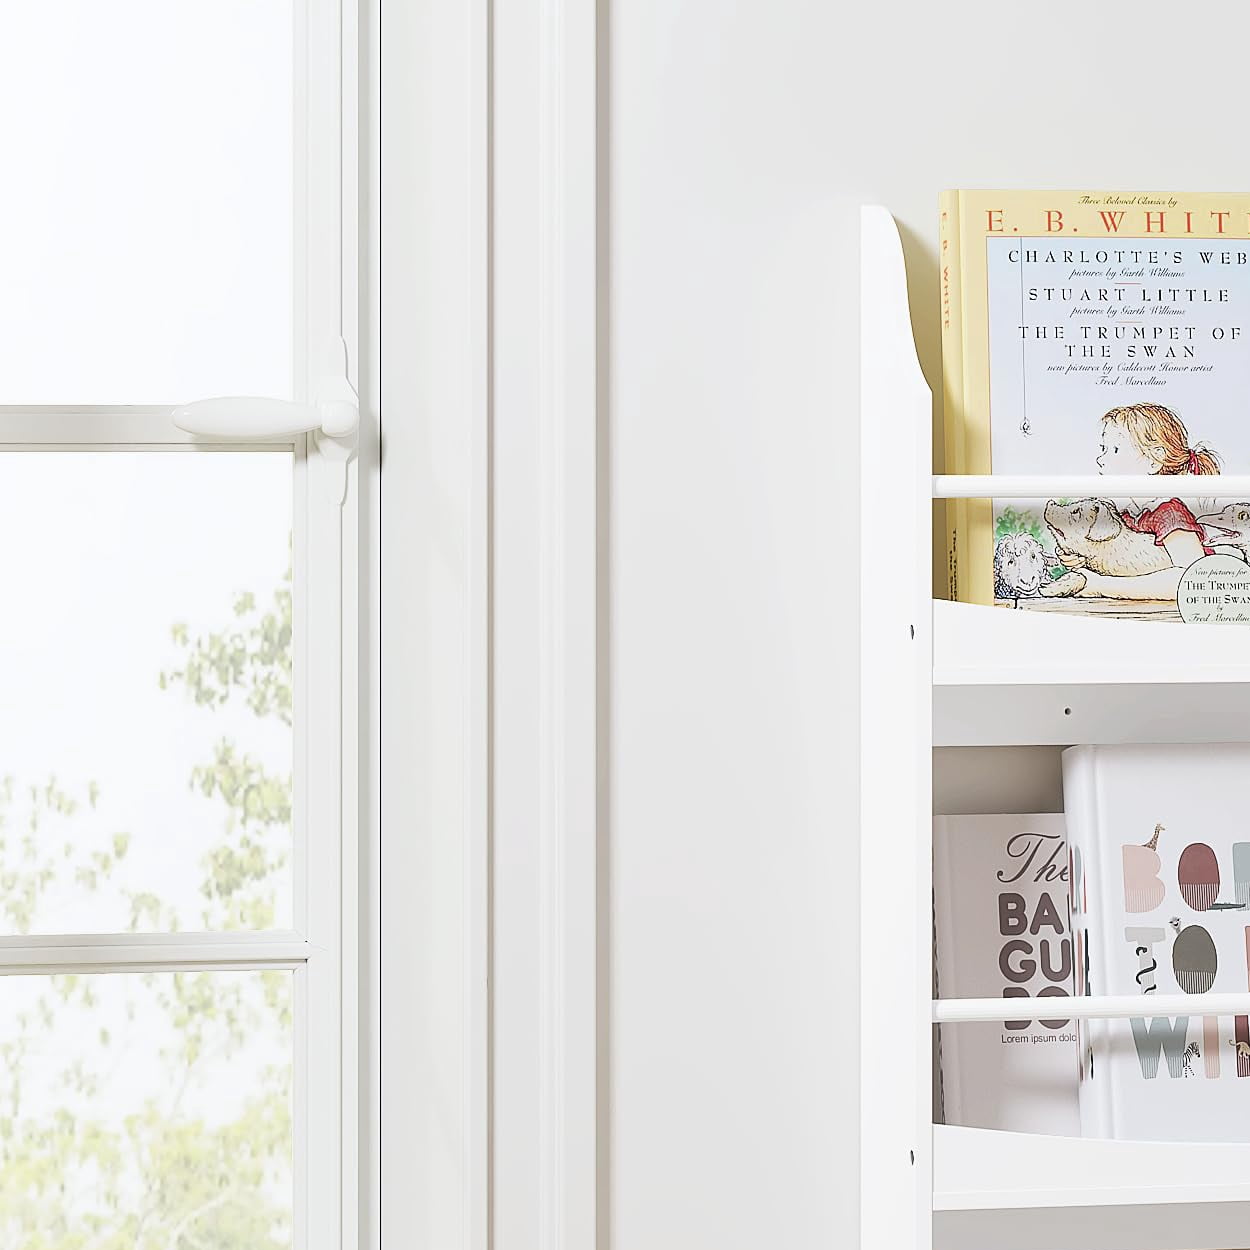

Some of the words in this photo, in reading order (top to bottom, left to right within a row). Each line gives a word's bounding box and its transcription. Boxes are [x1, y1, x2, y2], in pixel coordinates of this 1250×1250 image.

[1078, 195, 1100, 205] Three
[1103, 196, 1136, 205] Beloved
[1138, 196, 1166, 205] Classics
[1168, 197, 1178, 208] by
[1008, 250, 1183, 264] CHARLOTTE'S
[1199, 252, 1248, 265] WEB
[1069, 268, 1102, 280] pictures
[1105, 268, 1117, 280] by
[1119, 267, 1144, 277] Garth
[1149, 267, 1186, 278] Williams
[1028, 288, 1126, 301] STUART
[1141, 289, 1229, 302] LITTLE
[1070, 306, 1104, 318] pictures
[1106, 306, 1118, 318] by
[1120, 305, 1145, 315] Garth
[1150, 305, 1186, 316] Williams
[1018, 326, 1065, 340] THE
[1080, 326, 1196, 340] TRUMPET
[1212, 327, 1242, 340] OF
[1065, 345, 1111, 358] THE
[1127, 345, 1195, 358] SWAN
[1047, 364, 1066, 372] new
[1065, 363, 1100, 375] pictures
[1102, 362, 1113, 375] by
[1116, 362, 1156, 372] Caldecott
[1159, 362, 1189, 372] Honor
[1190, 363, 1213, 372] artist
[1095, 376, 1120, 386] Fred
[1184, 580, 1206, 591] THE
[1186, 596, 1199, 604] OF
[1201, 596, 1222, 604] THE
[997, 832, 1068, 883] The
[1124, 924, 1218, 995] TO
[1001, 1034, 1029, 1044] Lorem
[1031, 1033, 1057, 1045] ipsum
